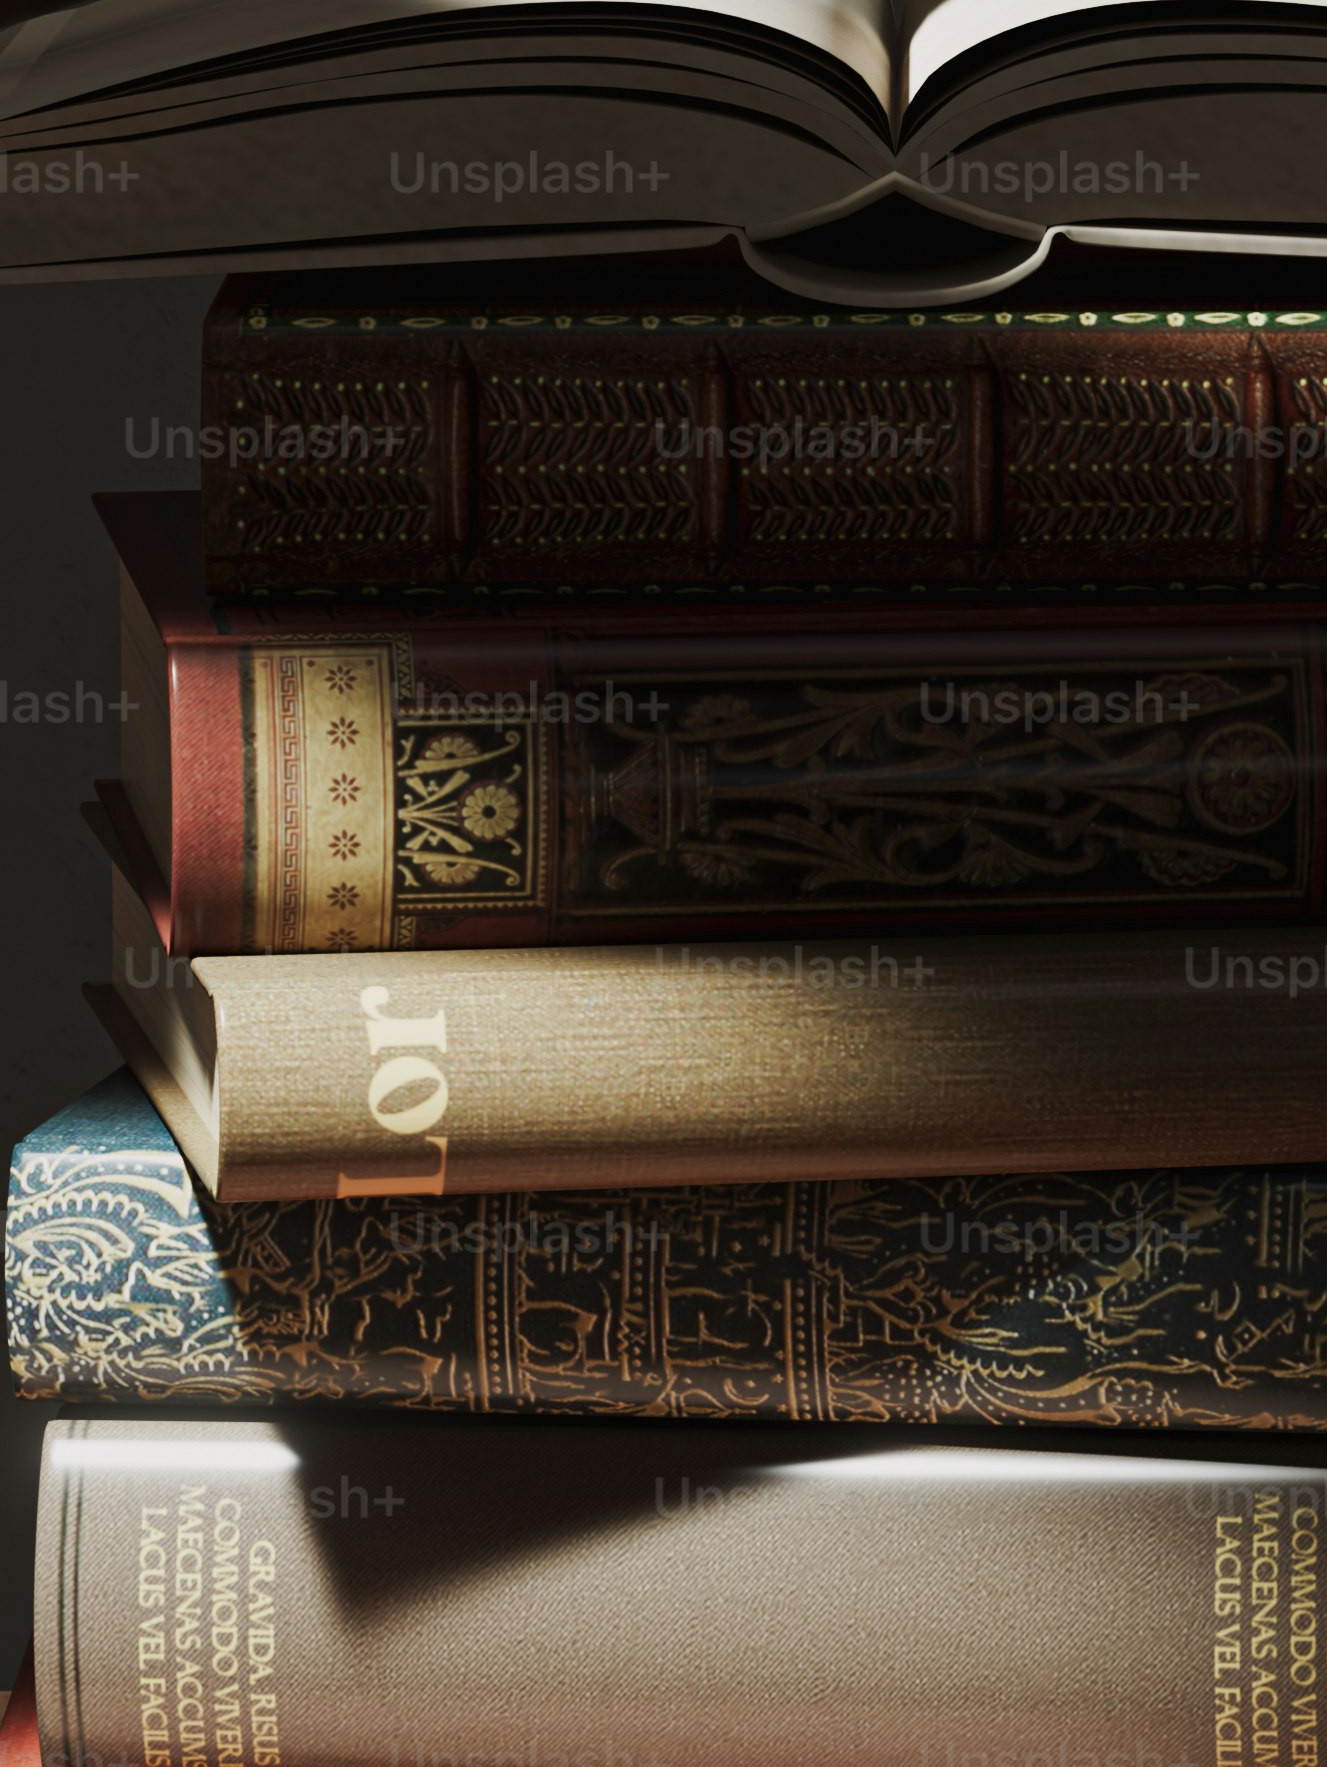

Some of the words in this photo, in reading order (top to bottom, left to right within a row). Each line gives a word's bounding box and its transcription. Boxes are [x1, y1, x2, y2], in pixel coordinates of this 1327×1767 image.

[138, 1507, 167, 1608] LACUS
[175, 1484, 206, 1649] MAECENAS
[211, 1498, 241, 1677] COMMODO
[1215, 1515, 1242, 1616] LACUS
[1250, 1493, 1280, 1659] MAECENAS
[1290, 1507, 1318, 1686] COMMODO
[138, 1615, 164, 1670] VEL
[248, 1540, 276, 1685] GRAVIDA.
[1214, 1622, 1241, 1678] VEL
[213, 1685, 243, 1767] VIVER
[250, 1693, 280, 1766] RISUS
